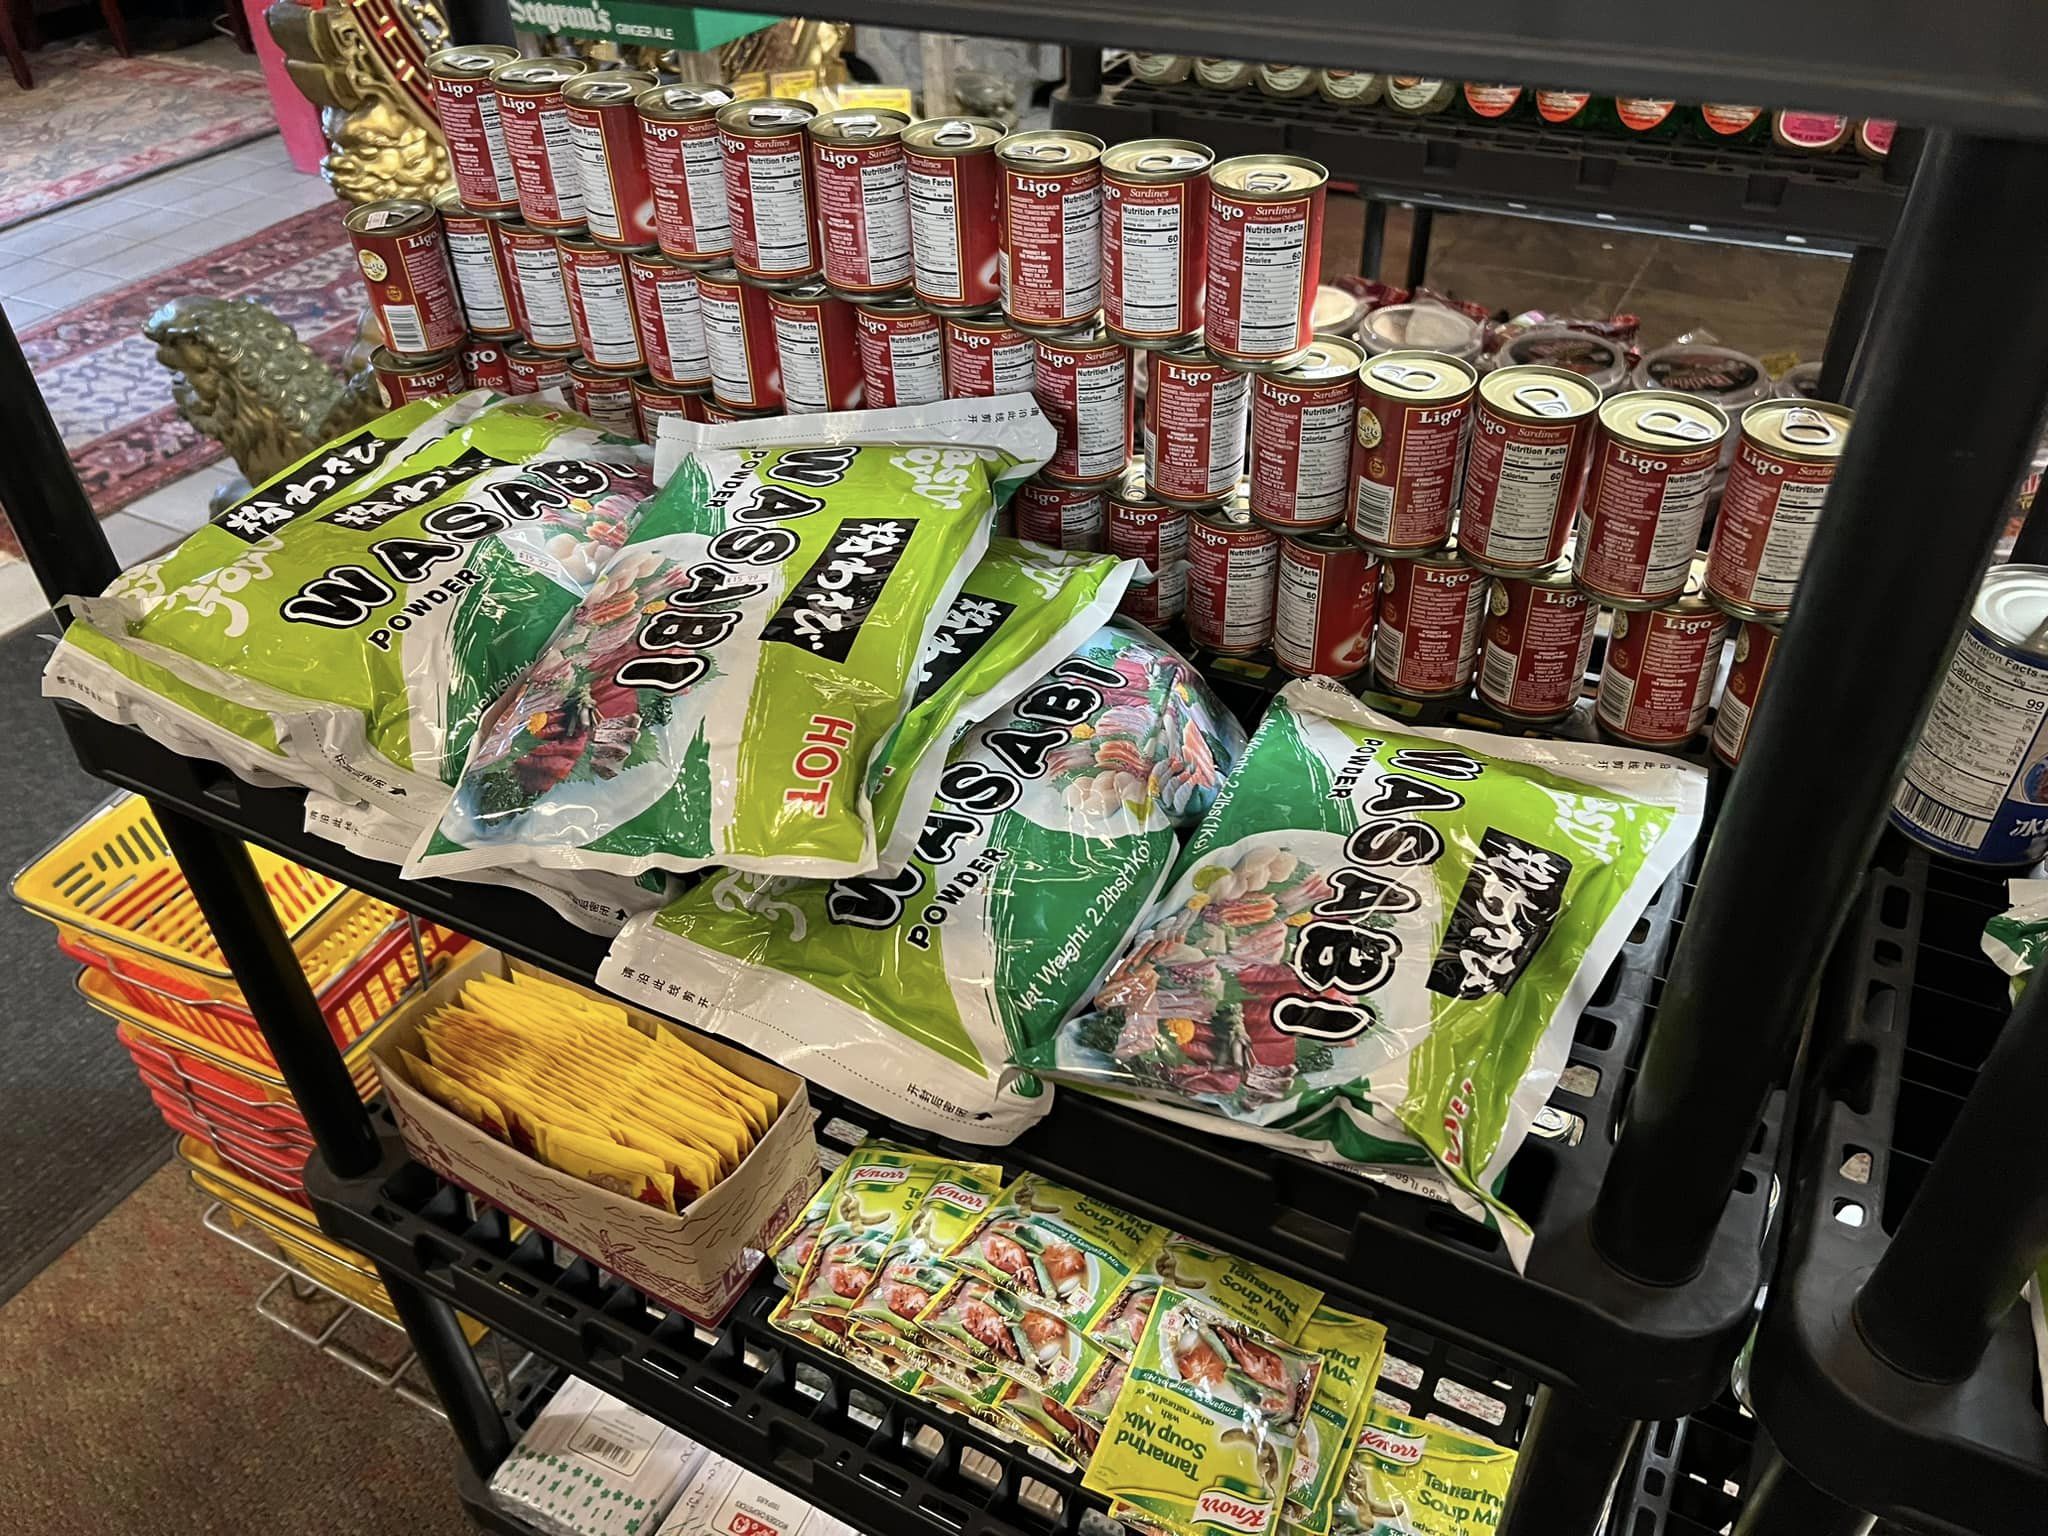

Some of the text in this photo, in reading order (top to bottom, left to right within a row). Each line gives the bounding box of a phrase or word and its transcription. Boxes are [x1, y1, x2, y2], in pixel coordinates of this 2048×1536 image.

[510, 0, 612, 33] Seagram's
[439, 80, 474, 98] Ligo
[502, 96, 536, 113] Ligo
[644, 121, 678, 141] Ligo
[720, 132, 746, 153] Ligo
[820, 148, 858, 168] Ligo
[1016, 177, 1061, 198] Ligo
[1129, 188, 1169, 198] Sardines
[1123, 206, 1178, 216] Nutrition Facts
[1211, 196, 1244, 221] Ligo
[1255, 206, 1297, 216] Sardines
[1245, 223, 1304, 235] Nutrition Facts
[407, 232, 439, 249] Ligo
[1123, 235, 1179, 245] Calories 60
[1244, 251, 1302, 265] Calories 60
[630, 263, 654, 279] Ligo
[858, 313, 887, 333] Ligo
[954, 328, 990, 349] Ligo
[463, 350, 498, 371] go
[508, 359, 534, 375] Ligo
[1039, 347, 1075, 368] Ligo
[409, 373, 444, 388] Ligo
[1168, 367, 1212, 386] Ligo
[1262, 383, 1301, 406] Ligo
[1302, 405, 1337, 417] Nutrition
[1418, 408, 1461, 426] Ligo
[1478, 407, 1507, 435] Ligo
[1302, 434, 1327, 442] Calories
[1517, 428, 1560, 439] Sardines
[1506, 442, 1567, 455] Nutrition Facts
[1616, 450, 1668, 474] Ligo
[1743, 447, 1784, 475] Ligo
[706, 446, 772, 509] POWDER
[1501, 470, 1561, 481] Calories 60
[1668, 472, 1703, 484] Nutrition
[1025, 487, 1060, 505] Ligo
[1782, 483, 1825, 494] Nutrition
[1119, 508, 1158, 525] Ligo
[1662, 502, 1689, 511] Calories
[1775, 512, 1807, 521] Calories
[1194, 524, 1228, 546] Ligo
[613, 445, 863, 693] WASABI
[1299, 565, 1319, 577] Facts
[1425, 571, 1470, 587] Ligo
[1306, 591, 1317, 600] 60
[367, 567, 486, 653] POWDER
[1663, 617, 1712, 634] Ligo
[2004, 656, 2039, 679] Facts
[1951, 659, 2045, 711] Calories 99
[784, 714, 857, 819] HOT
[1325, 737, 1386, 800] POWDER
[906, 846, 1011, 951] POWDER
[1271, 747, 1492, 1043] WASABI
[1014, 981, 1044, 1017] Net
[1035, 922, 1093, 985] Weight:
[853, 1166, 906, 1182] Knorr
[932, 1183, 985, 1210] Knorr
[1073, 1201, 1144, 1245] Soup Mix
[1108, 1254, 1120, 1267] Mix
[1228, 1262, 1300, 1316] Tamarind
[1219, 1274, 1293, 1328] Soup Mix
[1142, 1370, 1157, 1384] Mix
[1323, 1361, 1354, 1387] Mix
[1158, 1398, 1215, 1427] other natural
[1160, 1408, 1181, 1424] with
[1123, 1410, 1208, 1461] Soup Mix
[1359, 1430, 1419, 1458] Knorr
[1114, 1428, 1201, 1482] Tamarind
[1200, 1496, 1266, 1528] Knorr
[1417, 1488, 1471, 1525] Soup
